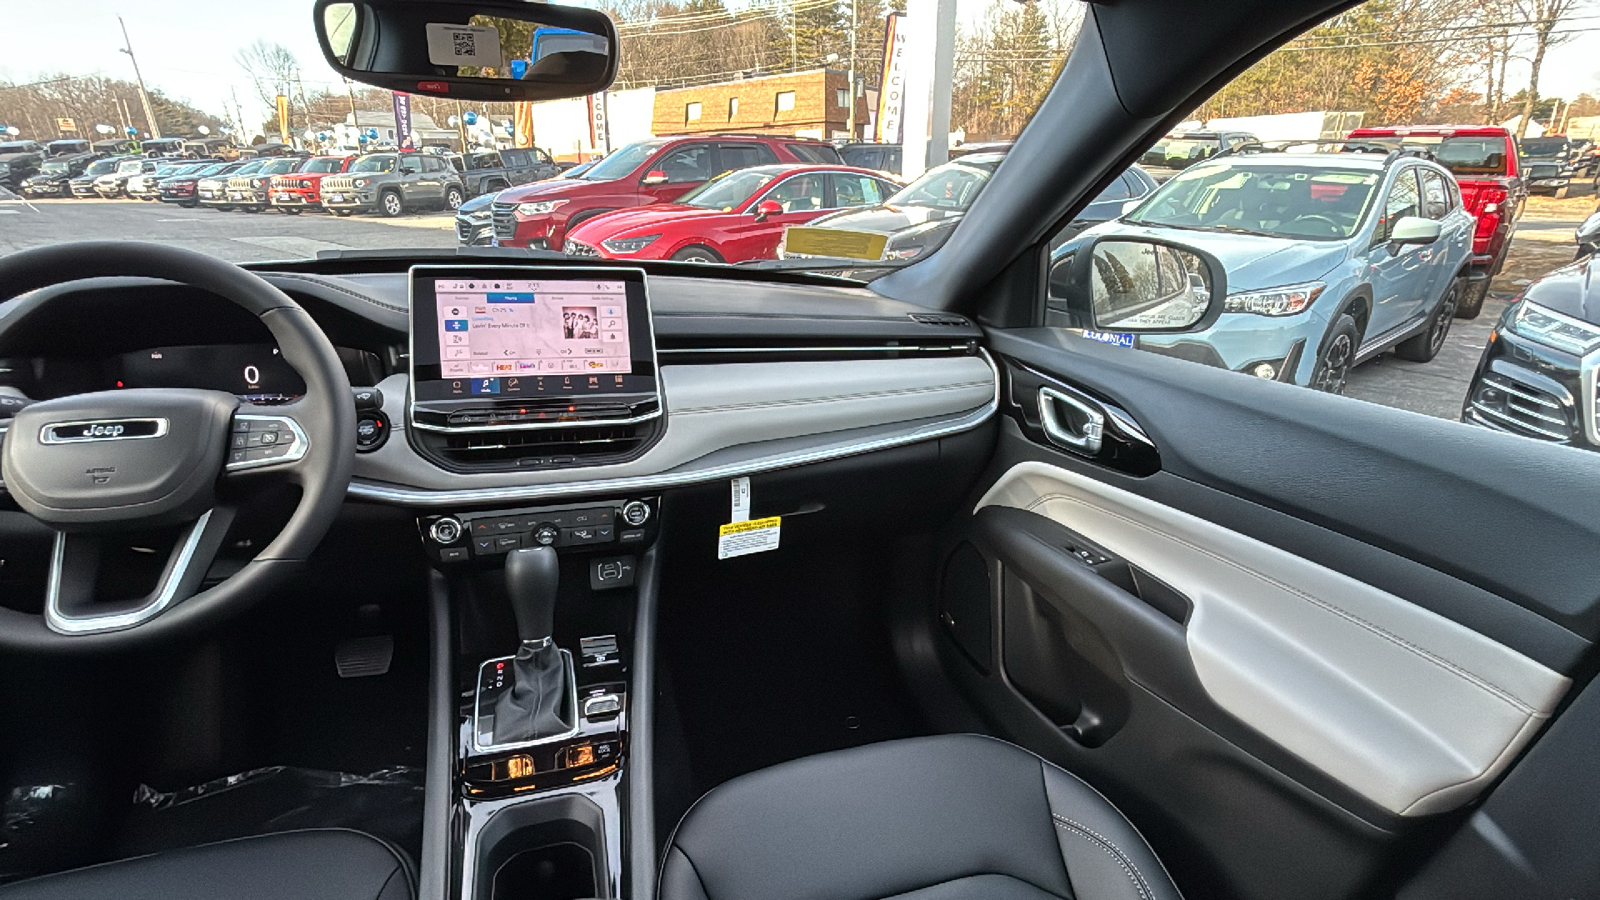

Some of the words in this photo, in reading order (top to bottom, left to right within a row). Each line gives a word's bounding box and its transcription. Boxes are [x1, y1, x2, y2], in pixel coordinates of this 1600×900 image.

[886, 33, 906, 130] WELCOME
[594, 92, 604, 141] LCOME
[244, 365, 260, 384] 0
[82, 423, 125, 437] Jeep
